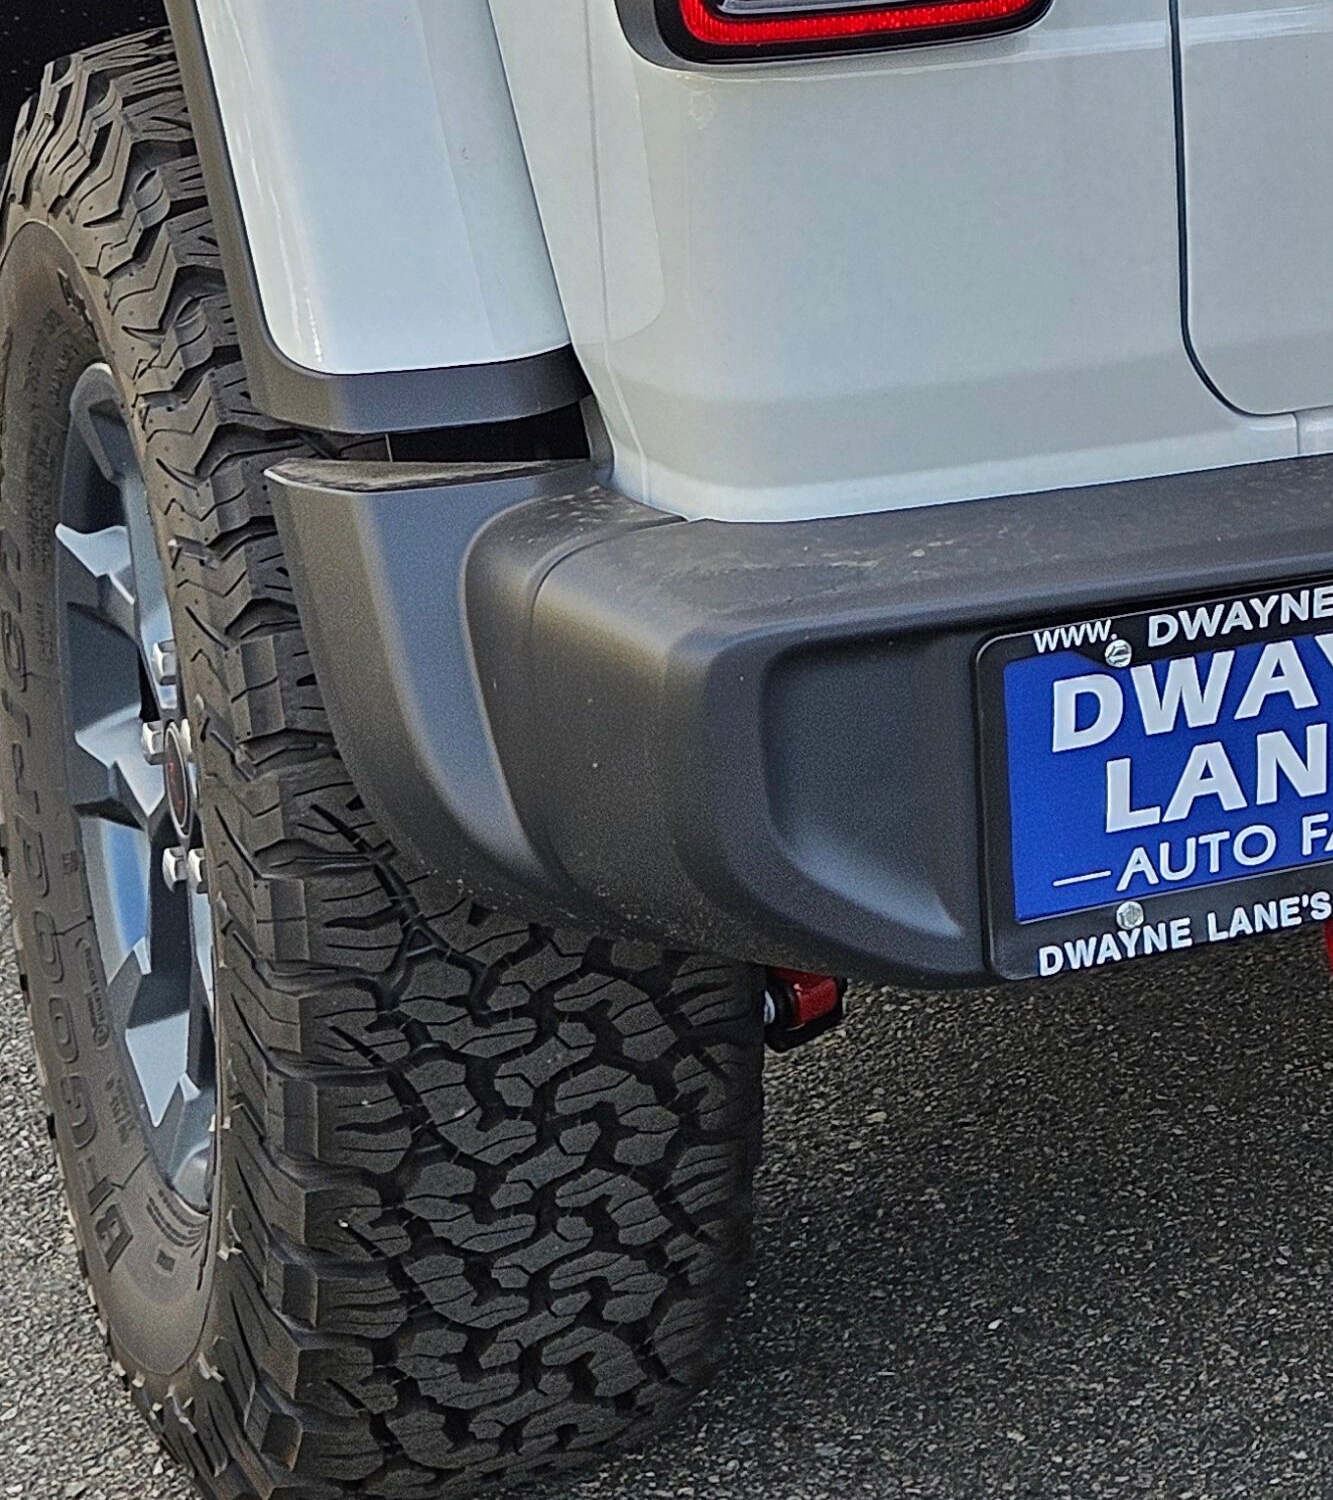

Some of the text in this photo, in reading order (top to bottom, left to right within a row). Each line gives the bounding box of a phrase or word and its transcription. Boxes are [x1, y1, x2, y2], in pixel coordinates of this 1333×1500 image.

[1116, 824, 1277, 891] AUTO
[1038, 917, 1192, 978] DWAYNE
[1207, 891, 1332, 943] LANE'S
